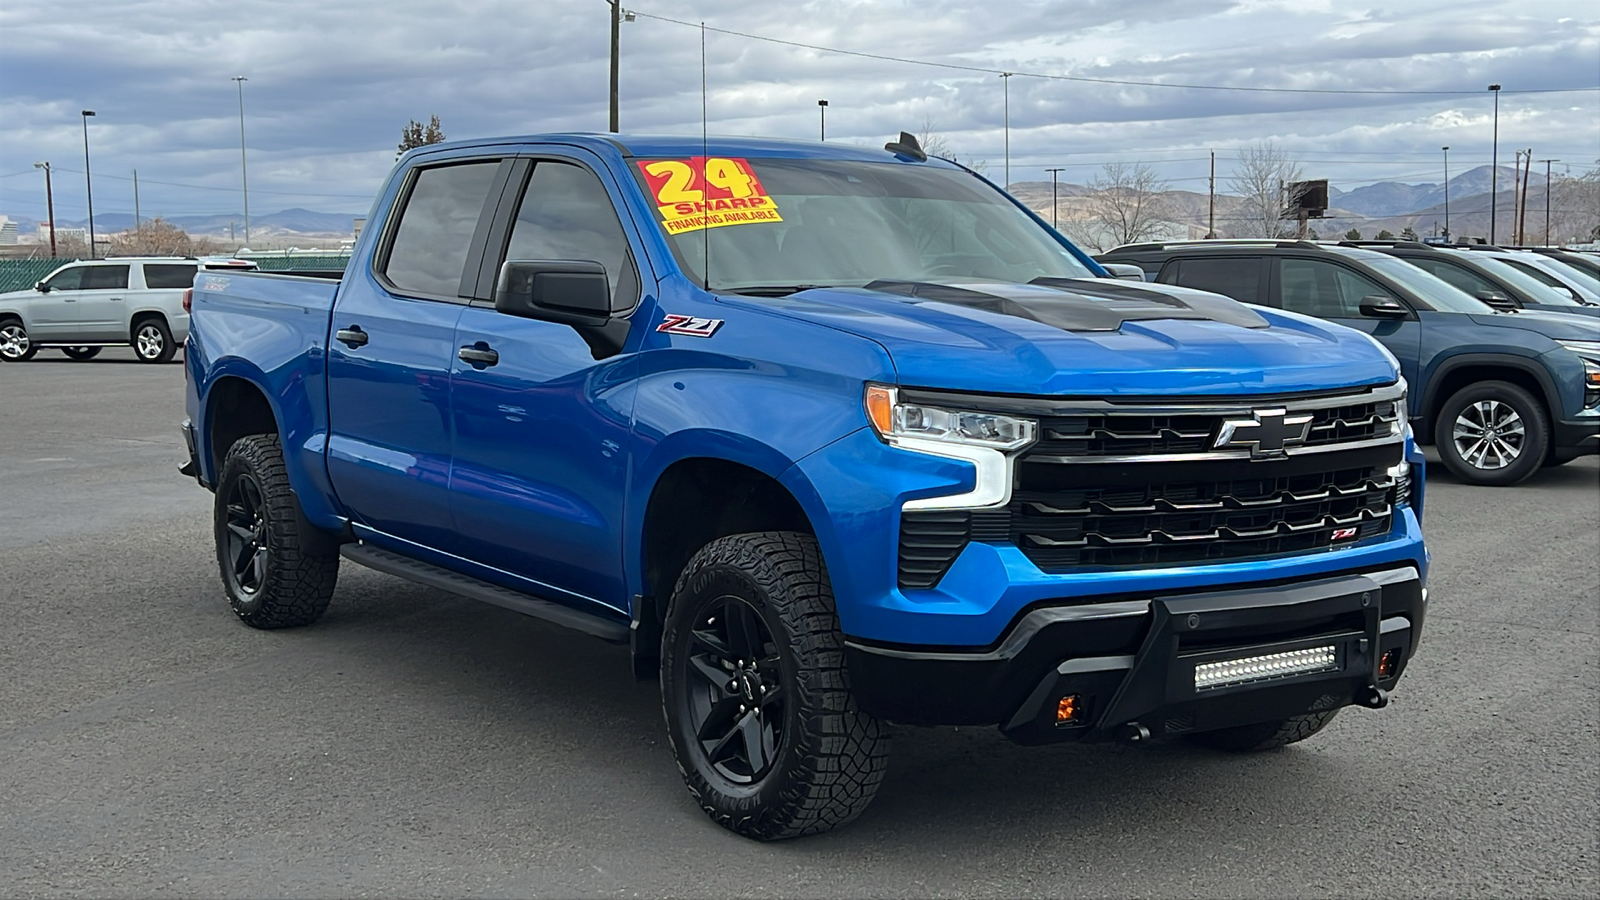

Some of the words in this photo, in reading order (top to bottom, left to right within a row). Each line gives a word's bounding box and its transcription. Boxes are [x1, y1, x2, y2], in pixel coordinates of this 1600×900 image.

[645, 158, 755, 203] 24
[675, 197, 766, 216] SHARP
[667, 214, 723, 231] FINANCING
[725, 210, 777, 223] AVAILABLE
[656, 314, 724, 338] Z71
